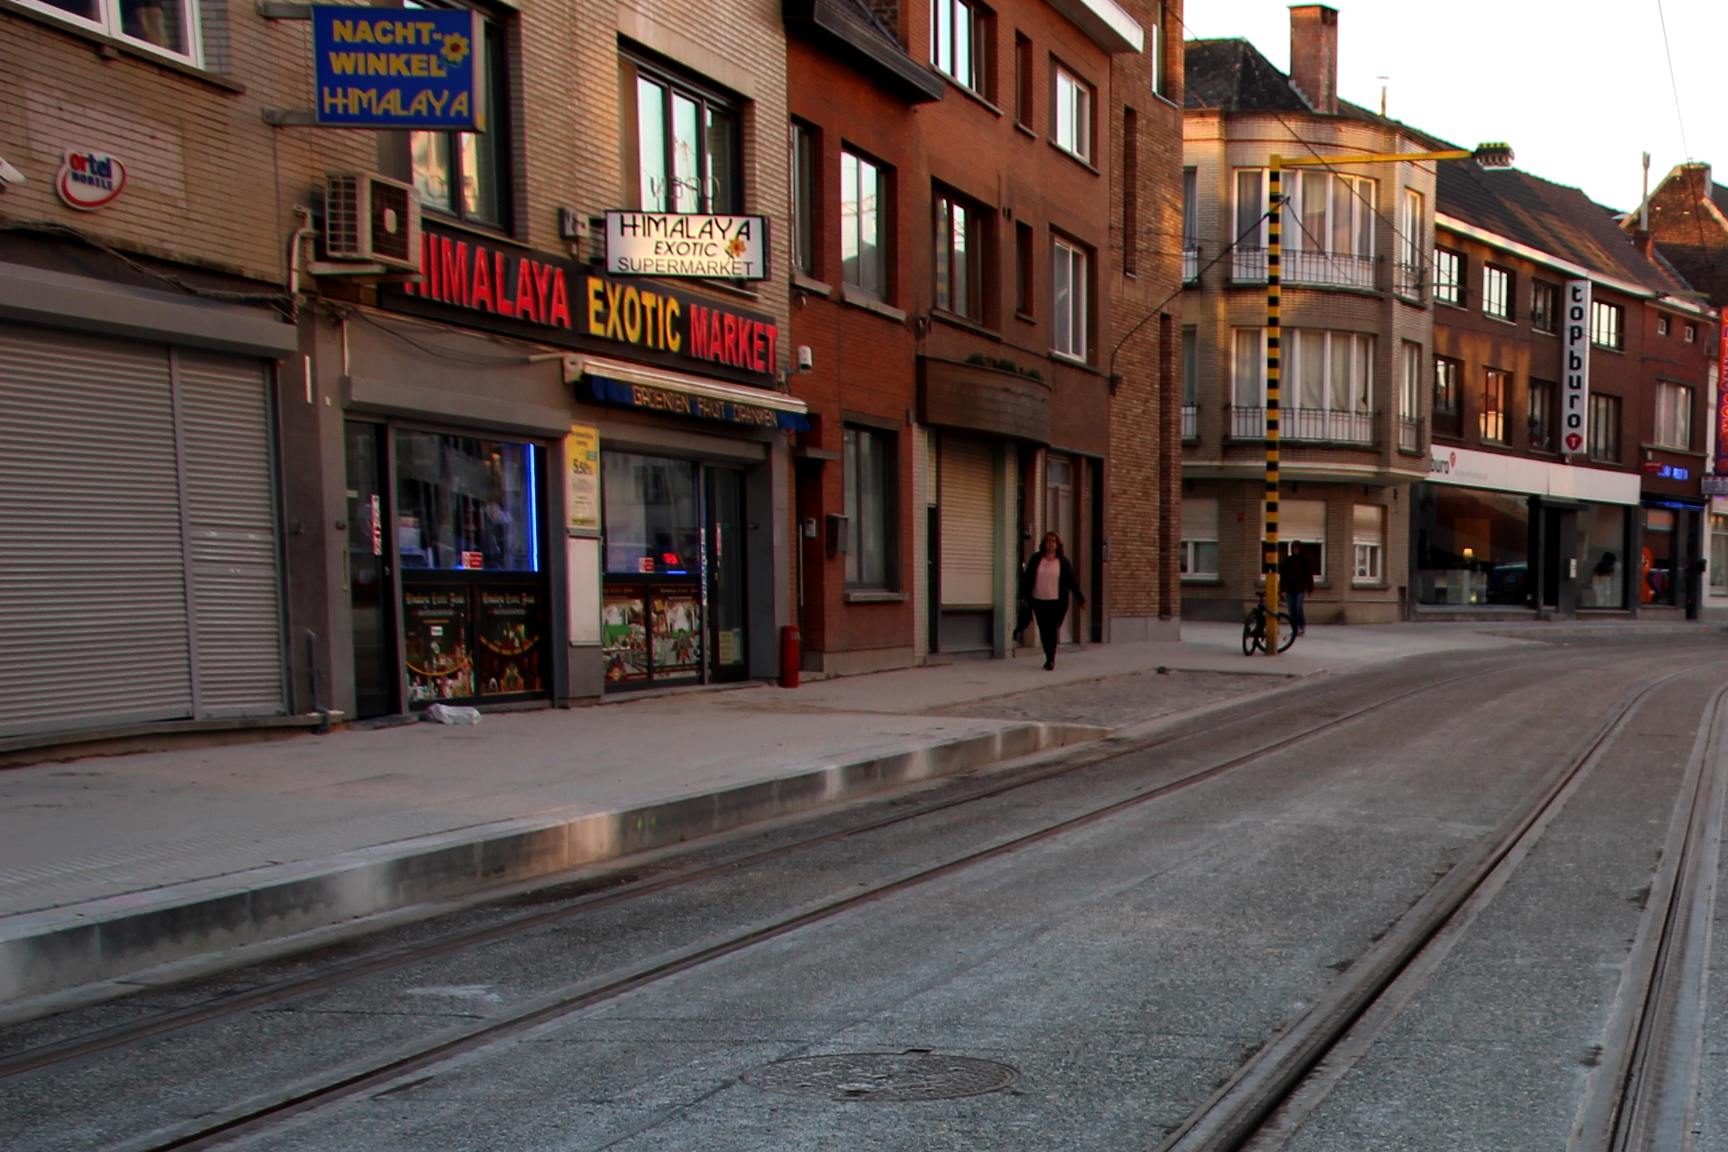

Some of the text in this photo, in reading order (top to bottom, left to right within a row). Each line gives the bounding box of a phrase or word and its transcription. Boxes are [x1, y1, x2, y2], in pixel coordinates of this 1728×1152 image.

[331, 19, 443, 45] NACHT-
[329, 52, 447, 77] WINKEL
[322, 86, 469, 117] HIMALAYA
[619, 214, 751, 241] HIMALAYA
[653, 241, 718, 257] EXOTIC
[617, 257, 753, 276] SUPERMARKET
[587, 276, 681, 353] EXOTIC
[689, 303, 778, 374] MARKET
[1567, 285, 1584, 429] topburo
